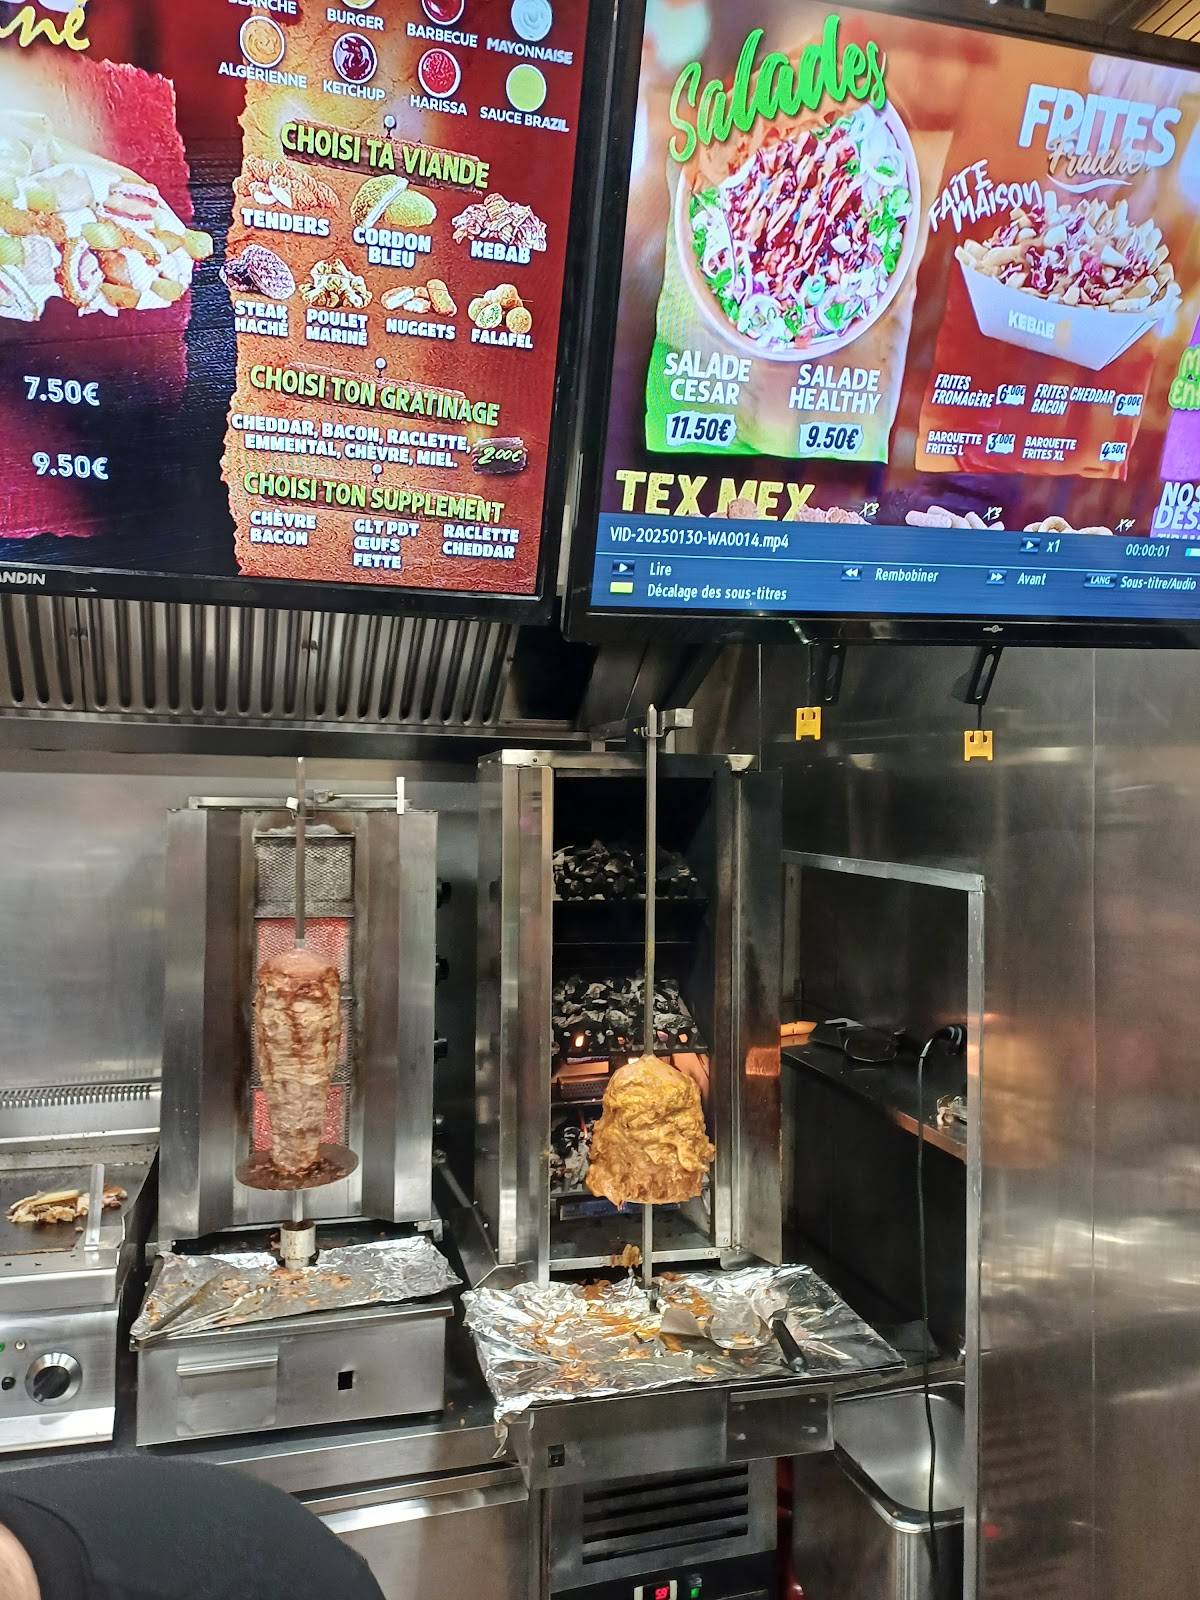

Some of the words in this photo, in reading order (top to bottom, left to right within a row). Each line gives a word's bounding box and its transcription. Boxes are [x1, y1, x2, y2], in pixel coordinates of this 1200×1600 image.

[326, 8, 384, 31] BURGER
[407, 23, 478, 48] BARBECUE
[486, 37, 573, 65] MAYONNAISE
[218, 61, 307, 89] ALGÉRIENNE
[323, 79, 386, 101] KETCHUP
[669, 15, 886, 162] Salades
[410, 95, 467, 116] HARISSA
[480, 106, 522, 124] SAUCE
[524, 114, 570, 132] BRAZIL
[1018, 83, 1182, 167] FRITES
[280, 122, 361, 162] CHOISI
[366, 139, 395, 170] TA
[404, 147, 490, 188] VIANDE
[241, 207, 330, 236] TENDERS
[353, 227, 432, 253] CORDON
[368, 248, 416, 268] BLEU
[470, 240, 530, 264] KEBAB
[235, 300, 288, 320] STEAK
[306, 308, 368, 329] POULET
[234, 317, 289, 338] HACHÉ
[306, 325, 367, 346] MARINÉ
[386, 318, 455, 340] NUGGETS
[471, 328, 533, 349] FALAFEL
[664, 350, 751, 383] SALADE
[798, 364, 880, 392] SALADE
[934, 373, 971, 391] FRITES
[24, 375, 100, 406] 7.50€
[250, 364, 325, 398] CHOISI
[331, 376, 376, 407] TON
[380, 385, 500, 426] GRATINAGE
[670, 378, 740, 405] CESAR
[788, 387, 882, 415] HEALTHY
[931, 389, 995, 408] FROMAGÈRE
[1034, 383, 1069, 401] FRITES
[1070, 386, 1116, 404] CHEDDAR
[1031, 399, 1068, 415] BACON
[231, 414, 318, 438] CHEDDAR,
[322, 423, 383, 444] BACON,
[387, 429, 470, 453] RACLETTE,
[671, 415, 731, 442] 11.50€
[806, 425, 859, 450] 9.50€
[928, 430, 983, 445] BARQUETTE
[245, 434, 341, 459] EMMENTAL,
[417, 451, 458, 467] MIEL.
[926, 443, 957, 455] FRITES
[957, 445, 964, 456] L
[1025, 436, 1077, 450] BARQUETTE
[1022, 448, 1052, 460] FRITES
[1053, 450, 1065, 461] XL
[32, 451, 109, 480] 9.50€
[244, 471, 317, 501] CHOISI
[323, 480, 366, 507] TON
[370, 489, 505, 523] SUPPLEMENT
[616, 469, 708, 516] TEX
[717, 477, 815, 521] MEX
[250, 509, 316, 530] CHÈVRE
[1154, 504, 1200, 529] DES
[250, 527, 308, 545] BACON
[354, 519, 385, 535] GLT
[387, 521, 420, 537] PDT
[443, 524, 520, 543] RACLETTE
[442, 541, 515, 559] CHEDDAR
[610, 526, 789, 553] VID-20250130-WA0014.mp4
[1126, 543, 1170, 557] 00:00:01
[353, 553, 402, 569] FETTE
[649, 562, 672, 576] Lire
[875, 568, 939, 582] Rembobiner
[1017, 572, 1047, 586] Avant
[1090, 575, 1111, 586] LANG
[1120, 576, 1197, 591] Sous-titre/Audio
[647, 583, 698, 602] Décalage
[701, 585, 722, 599] des
[725, 586, 787, 601] sous-titres
